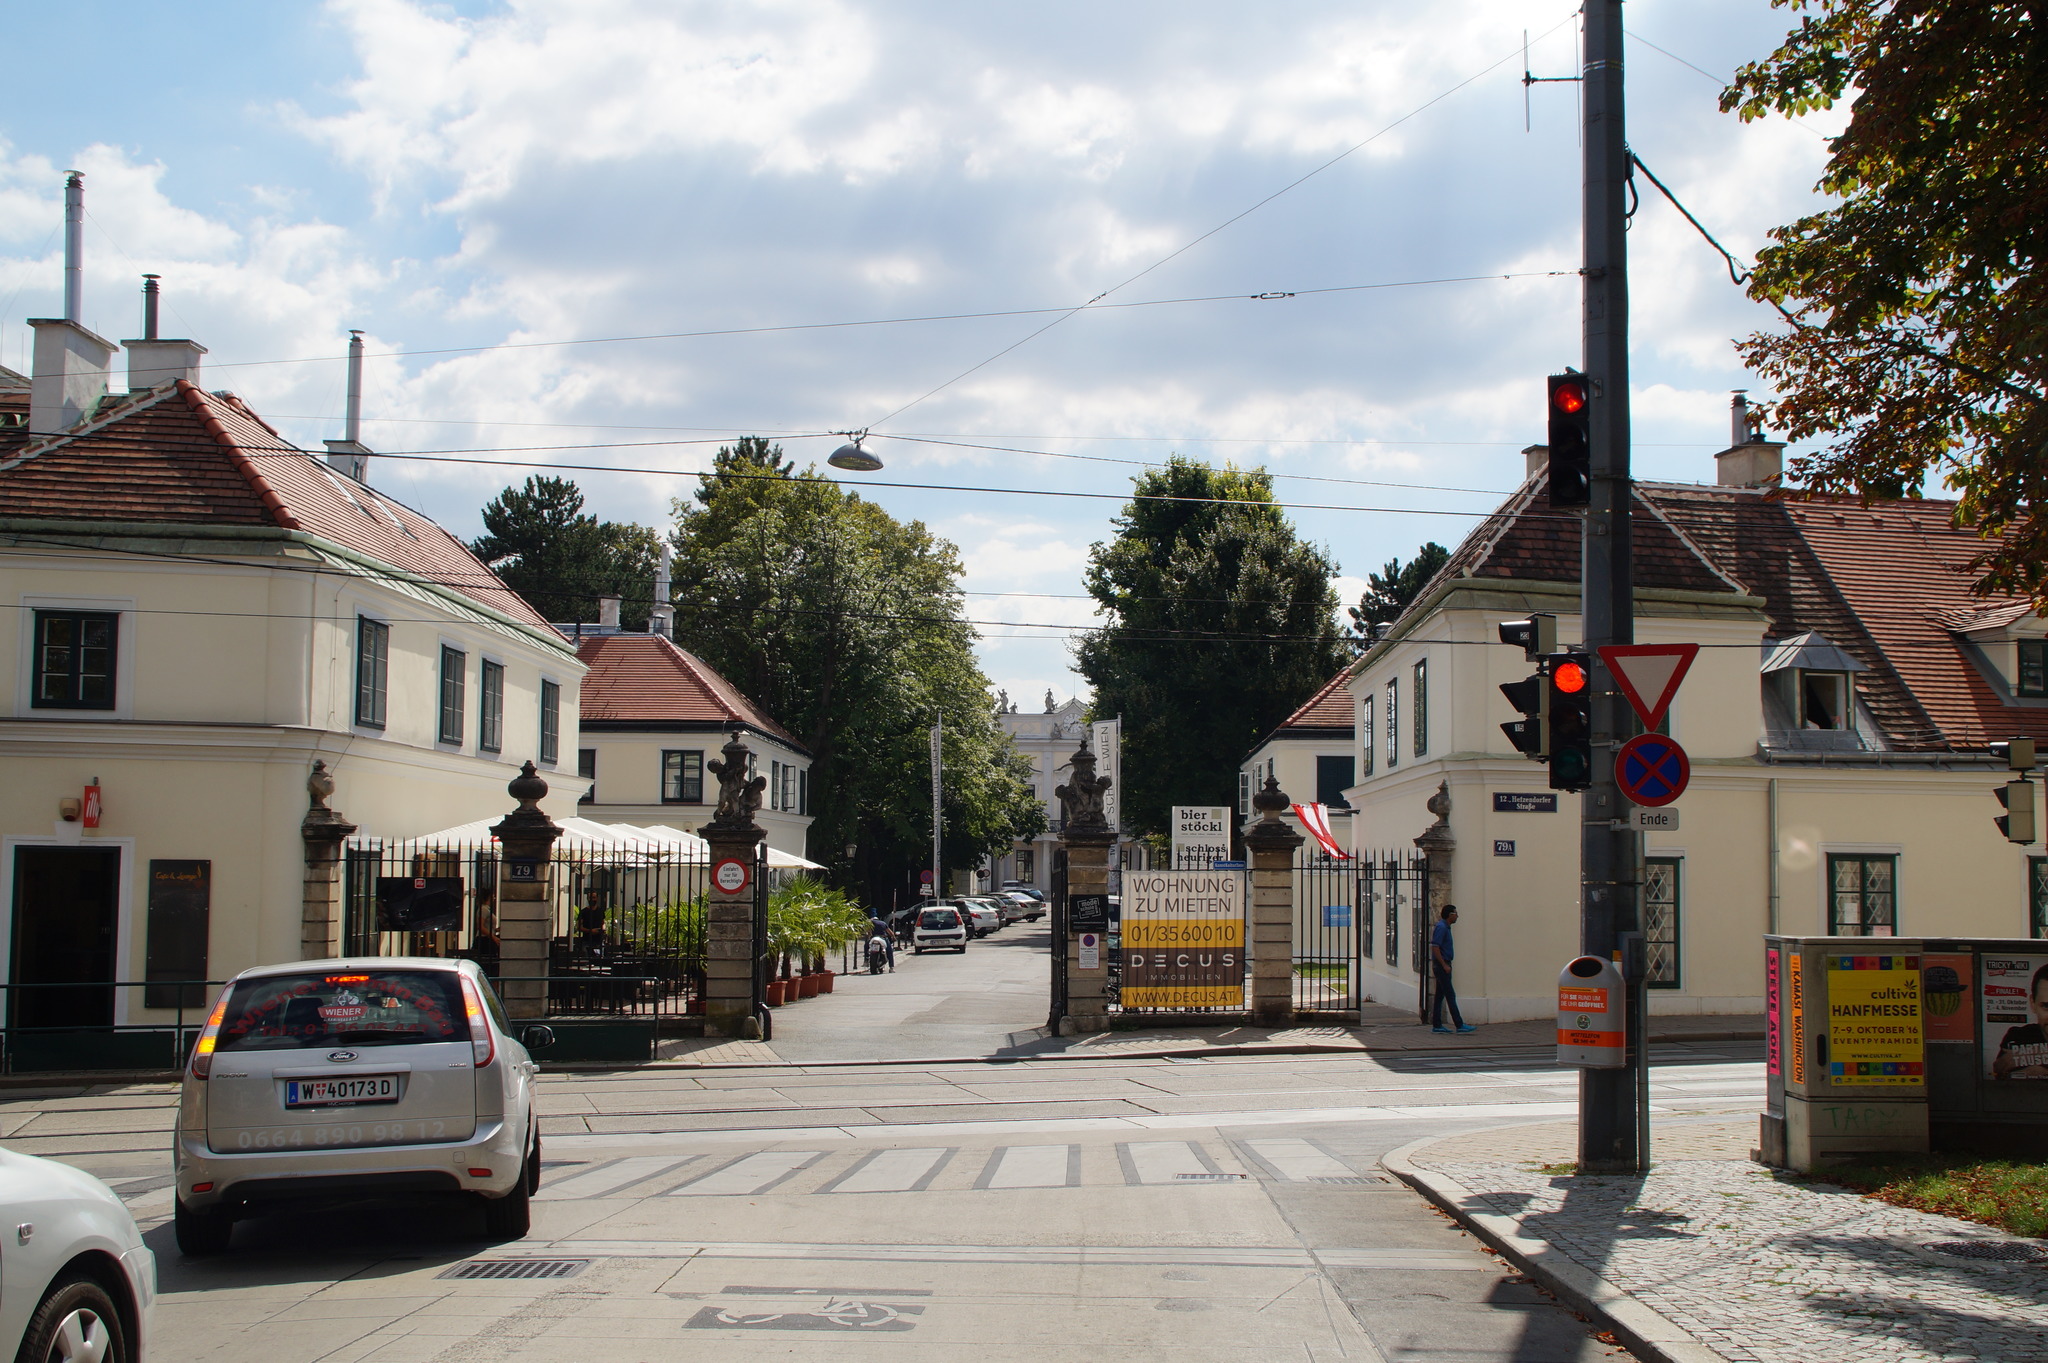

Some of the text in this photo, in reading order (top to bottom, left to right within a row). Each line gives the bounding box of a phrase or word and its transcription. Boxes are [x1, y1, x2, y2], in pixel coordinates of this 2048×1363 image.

[1101, 726, 1109, 755] WIEN
[86, 792, 99, 824] illy
[1516, 803, 1535, 811] Straße
[1181, 809, 1207, 819] bier
[1640, 813, 1668, 825] Ende
[516, 866, 530, 876] 79
[1133, 878, 1234, 893] WOHNUNG
[1135, 898, 1231, 913] ZU MIETEN
[1131, 954, 1235, 967] DECUS
[1769, 956, 1777, 1012] STEVE
[1793, 970, 1801, 1009] KAMASI
[1132, 991, 1235, 1003] WWW.DECUS.AT
[1871, 987, 1917, 999] cultiva
[228, 980, 320, 1034] Wiener
[415, 995, 455, 1035] Bau
[325, 1008, 361, 1016] WIENER
[1832, 1005, 1917, 1016] HANFMESSE
[1857, 1026, 1904, 1034] OKTOBER
[1794, 1015, 1803, 1083] WASHINGTON
[238, 1121, 445, 1149] 0664 890 98 12
